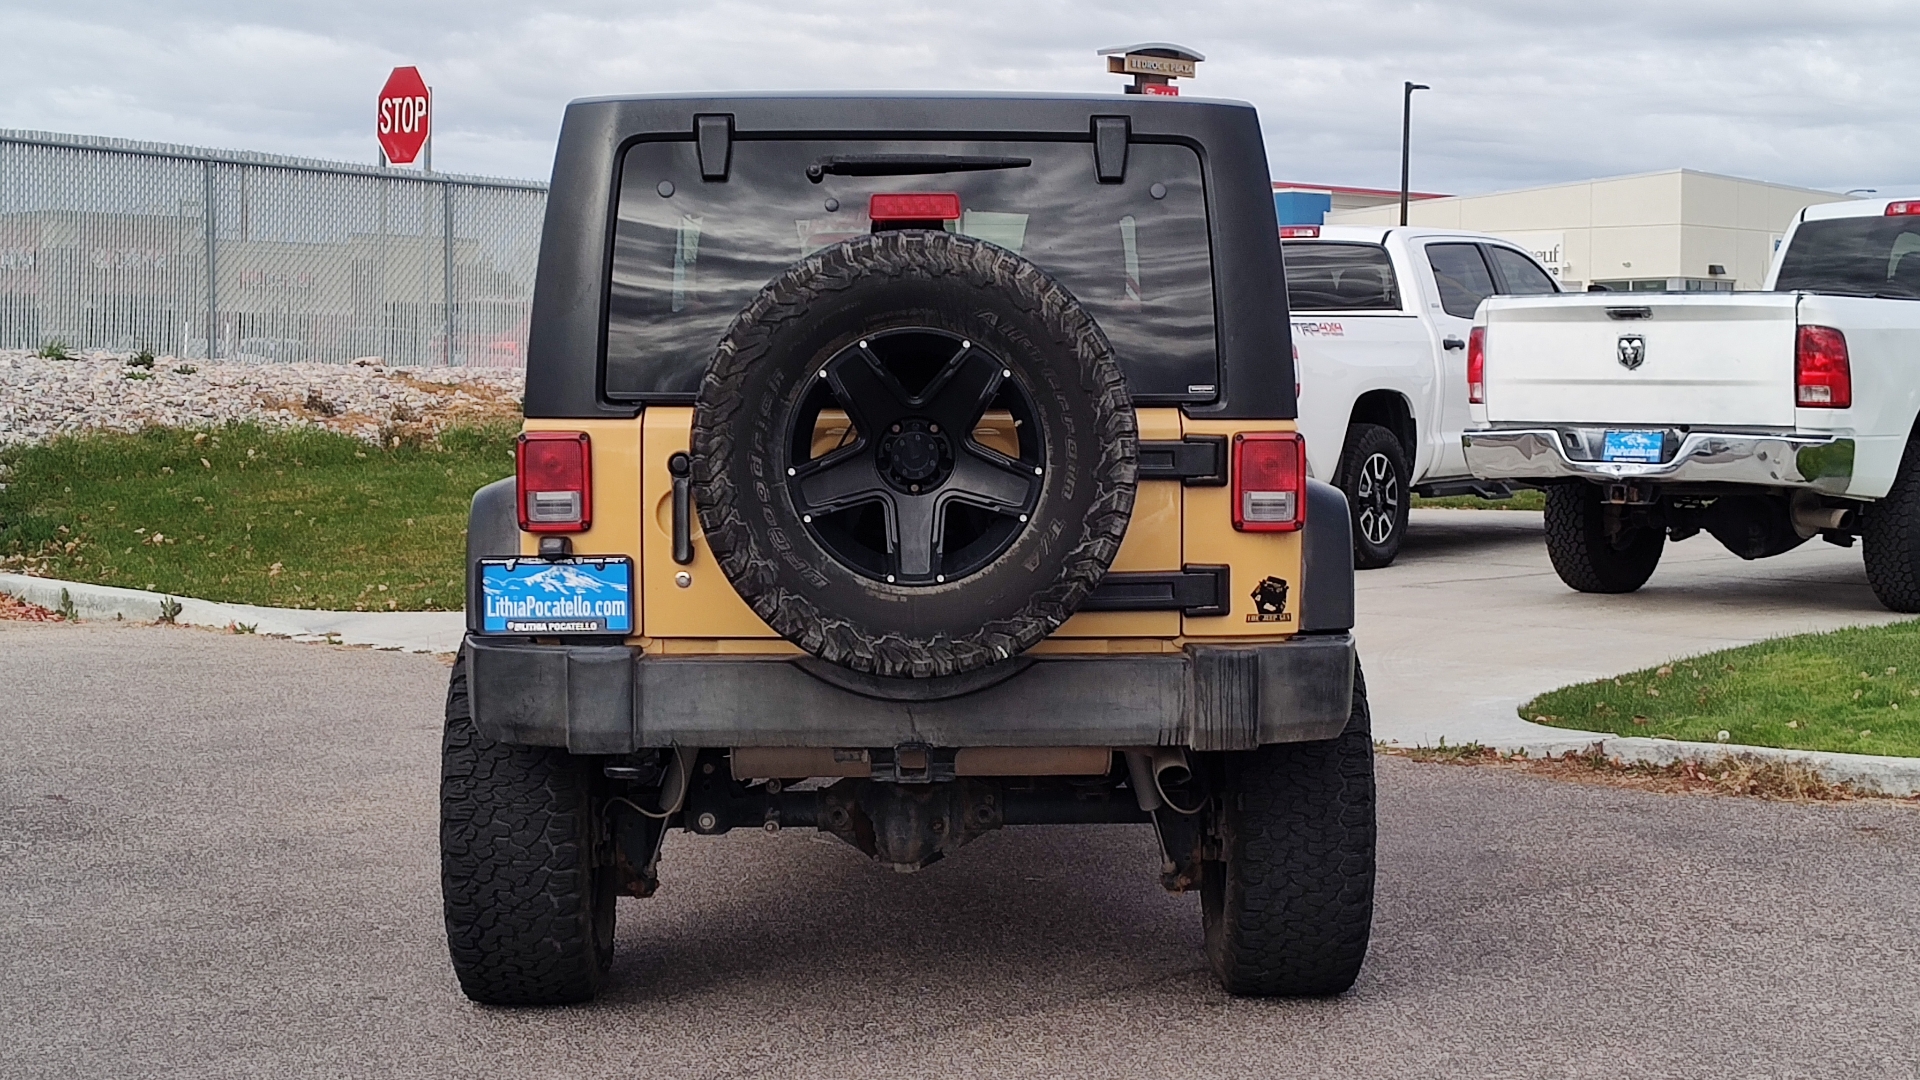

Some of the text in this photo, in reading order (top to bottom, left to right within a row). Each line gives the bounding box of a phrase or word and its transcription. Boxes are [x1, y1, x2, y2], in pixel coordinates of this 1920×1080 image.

[1170, 62, 1194, 74] PLAZA
[380, 96, 427, 134] STOP
[1530, 243, 1560, 263] euf
[748, 367, 831, 591] BFGoodrich
[486, 595, 626, 617] LithiaPocatello.com
[548, 621, 598, 631] POCATELLO
